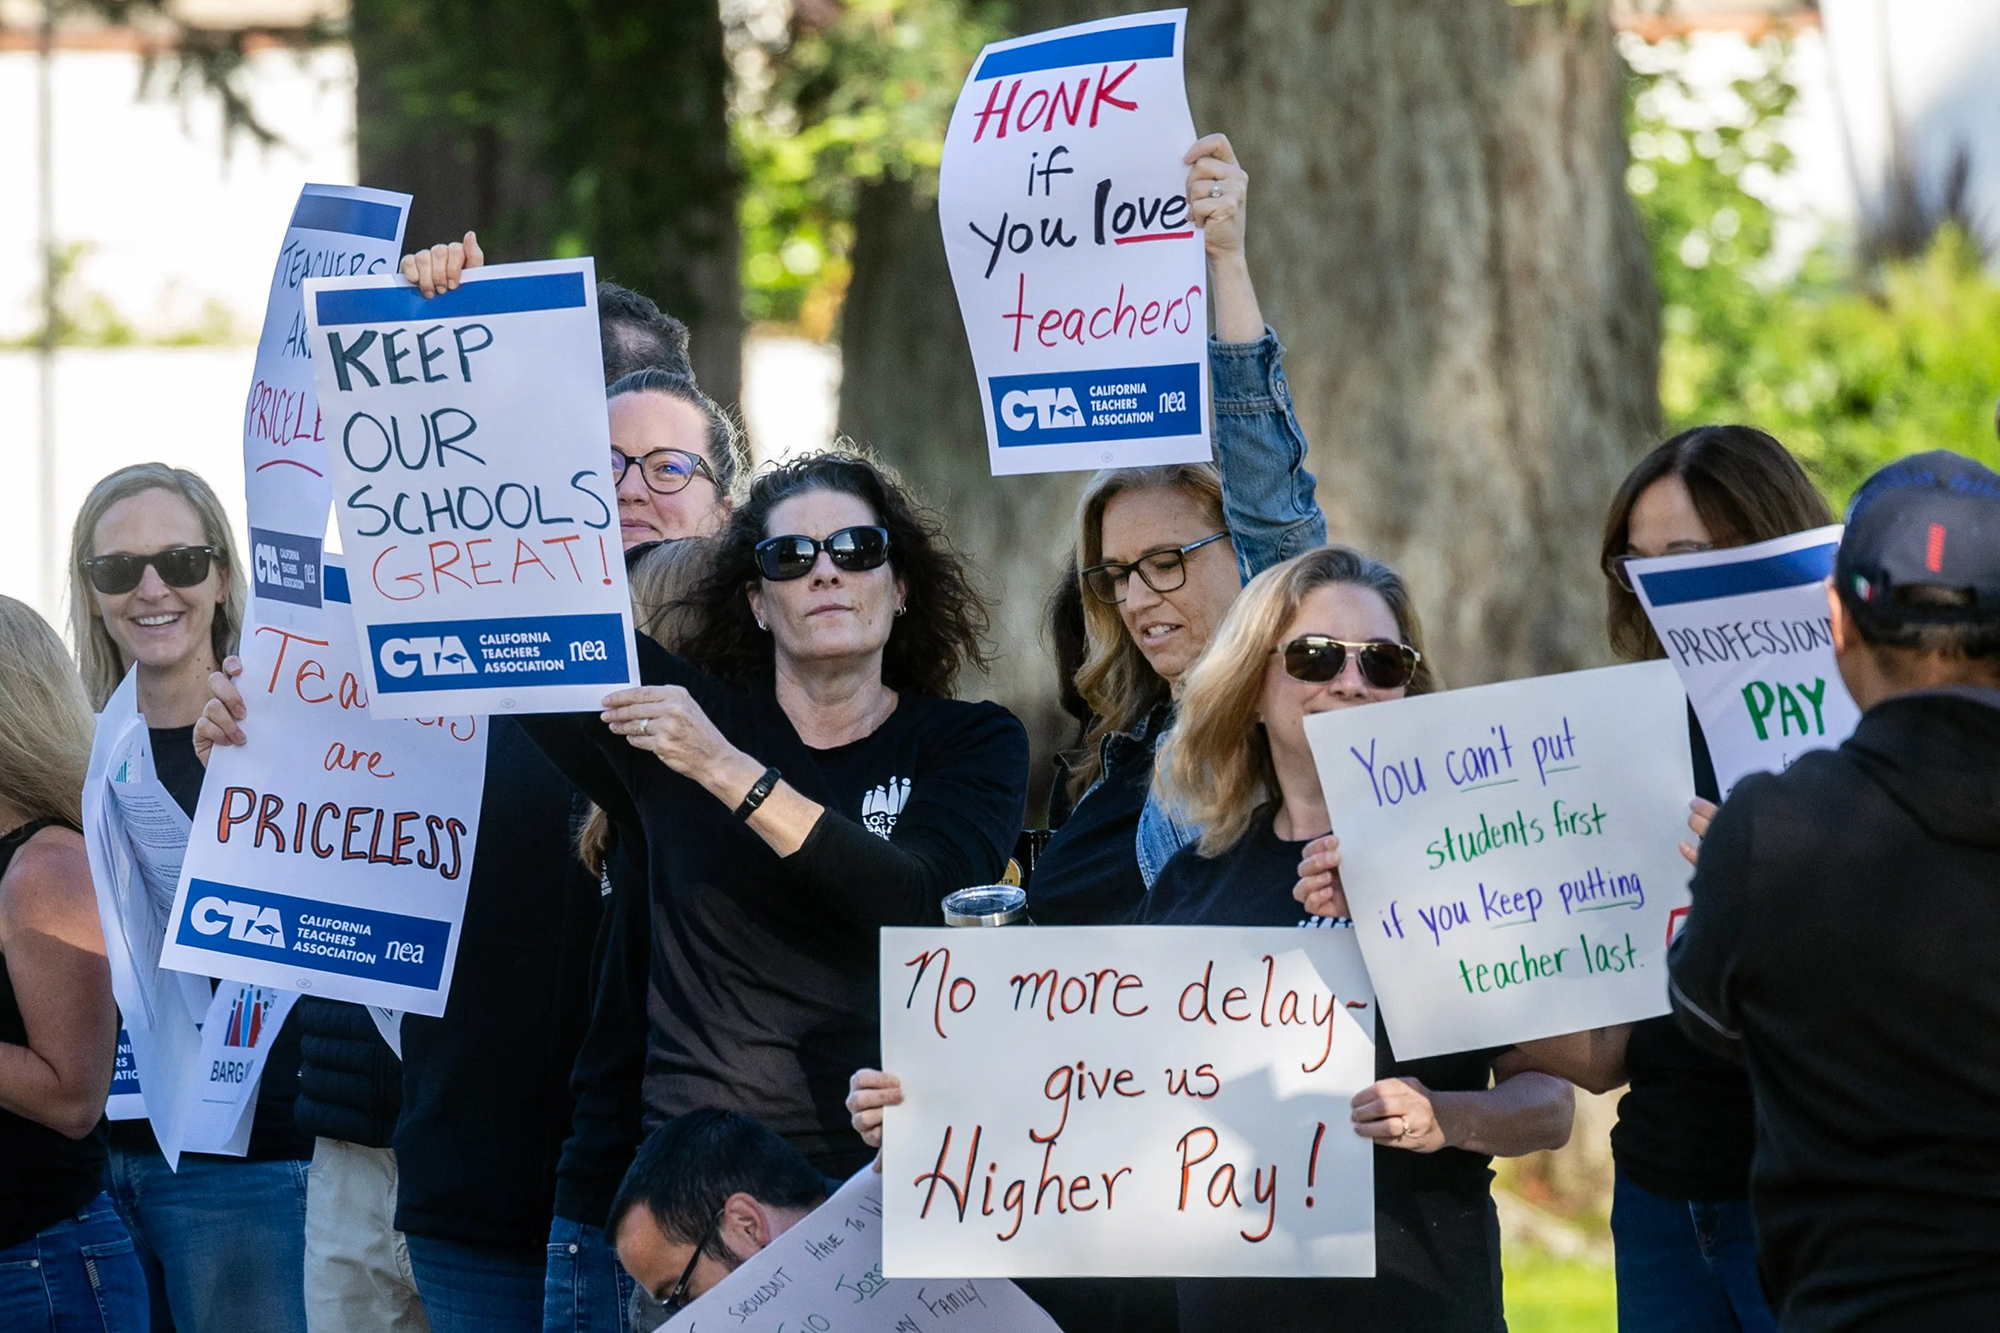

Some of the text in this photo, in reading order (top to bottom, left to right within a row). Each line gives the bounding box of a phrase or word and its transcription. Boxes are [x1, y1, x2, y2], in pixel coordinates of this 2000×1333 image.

[974, 63, 1138, 143] HONK
[1028, 145, 1074, 196] if
[970, 179, 1188, 279] you love
[281, 310, 312, 359] AR
[1002, 273, 1201, 352] teachers
[327, 323, 494, 391] KEEP
[1001, 387, 1086, 431] CTA
[1089, 383, 1147, 397] CALIFORNIA
[1091, 398, 1137, 411] TEACHERS
[1159, 391, 1186, 413] nea
[343, 408, 486, 473] OUR
[1091, 411, 1154, 426] ASSOCIATION
[347, 471, 611, 536] SCHOOLS
[255, 543, 282, 587] CTA
[373, 535, 612, 600] GREAT!
[380, 636, 478, 678] CTA
[479, 632, 551, 646] CALIFORNIA
[481, 646, 540, 660] TEACHERS
[569, 640, 607, 662] nea
[484, 659, 565, 673] ASSOCIATION
[1741, 677, 1825, 740] PAY
[324, 742, 394, 778] are
[1350, 717, 1576, 807] You can't put
[217, 787, 466, 880] PRICELESS
[1426, 799, 1607, 870] students first
[191, 896, 286, 948] CTA
[299, 914, 372, 936] CALIFORNIA
[1378, 867, 1645, 946] if you keep putting
[293, 941, 376, 964] ASSOCIATION
[296, 927, 356, 947] TEACHERS
[385, 940, 424, 964] nea
[1459, 933, 1644, 993] teacher last.
[905, 947, 976, 1038] No
[1011, 968, 1148, 1021] more
[1030, 1060, 1220, 1143] give us
[914, 1125, 1131, 1241] Higher
[917, 1279, 987, 1318] FAMILY
